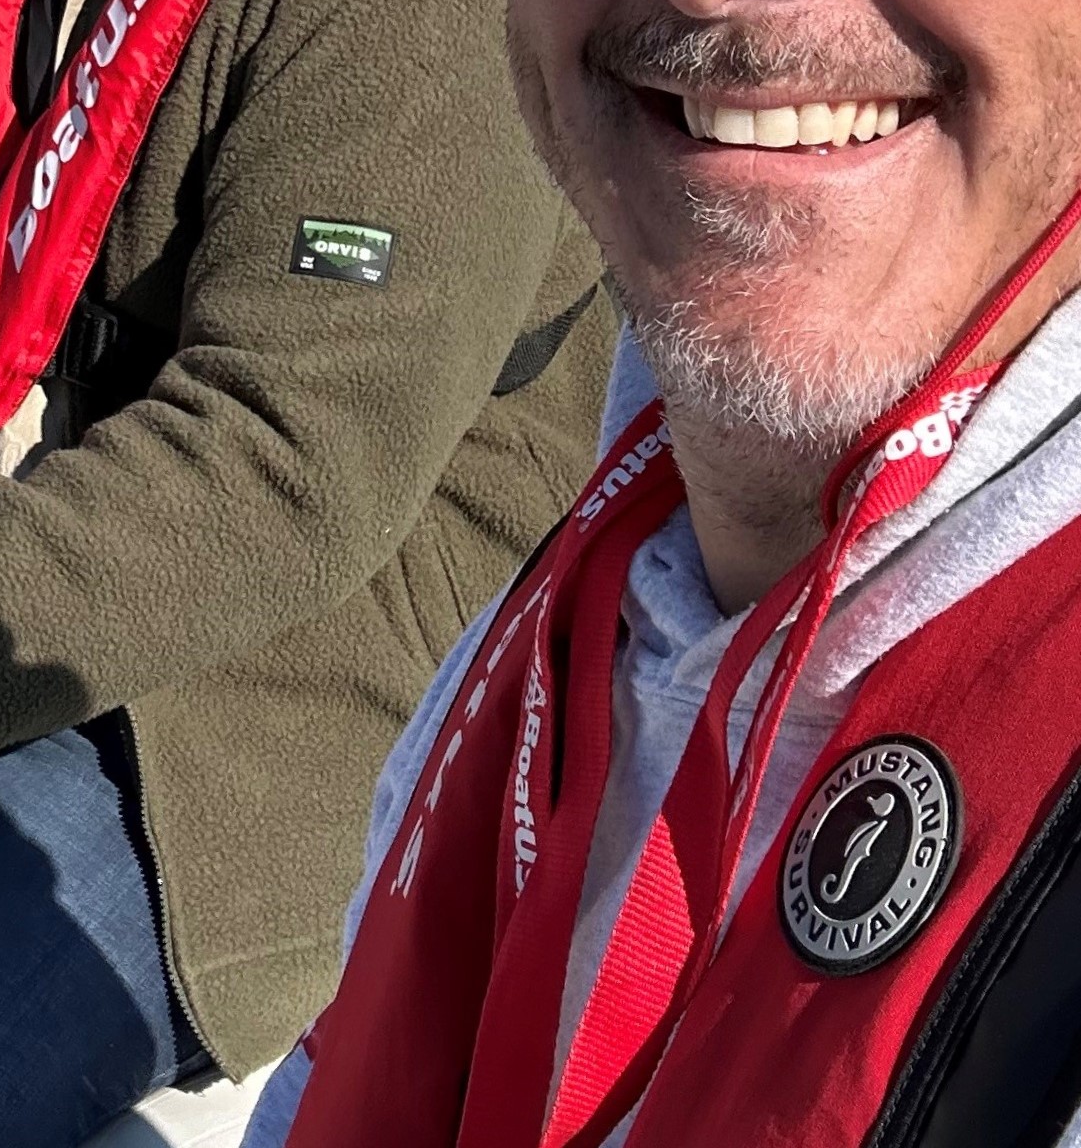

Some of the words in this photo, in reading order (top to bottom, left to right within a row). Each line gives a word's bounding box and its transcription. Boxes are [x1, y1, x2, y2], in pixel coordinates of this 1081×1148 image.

[315, 240, 371, 261] ORVIS
[824, 751, 941, 868] MUSTANG
[789, 828, 911, 951] SURVIVAL
